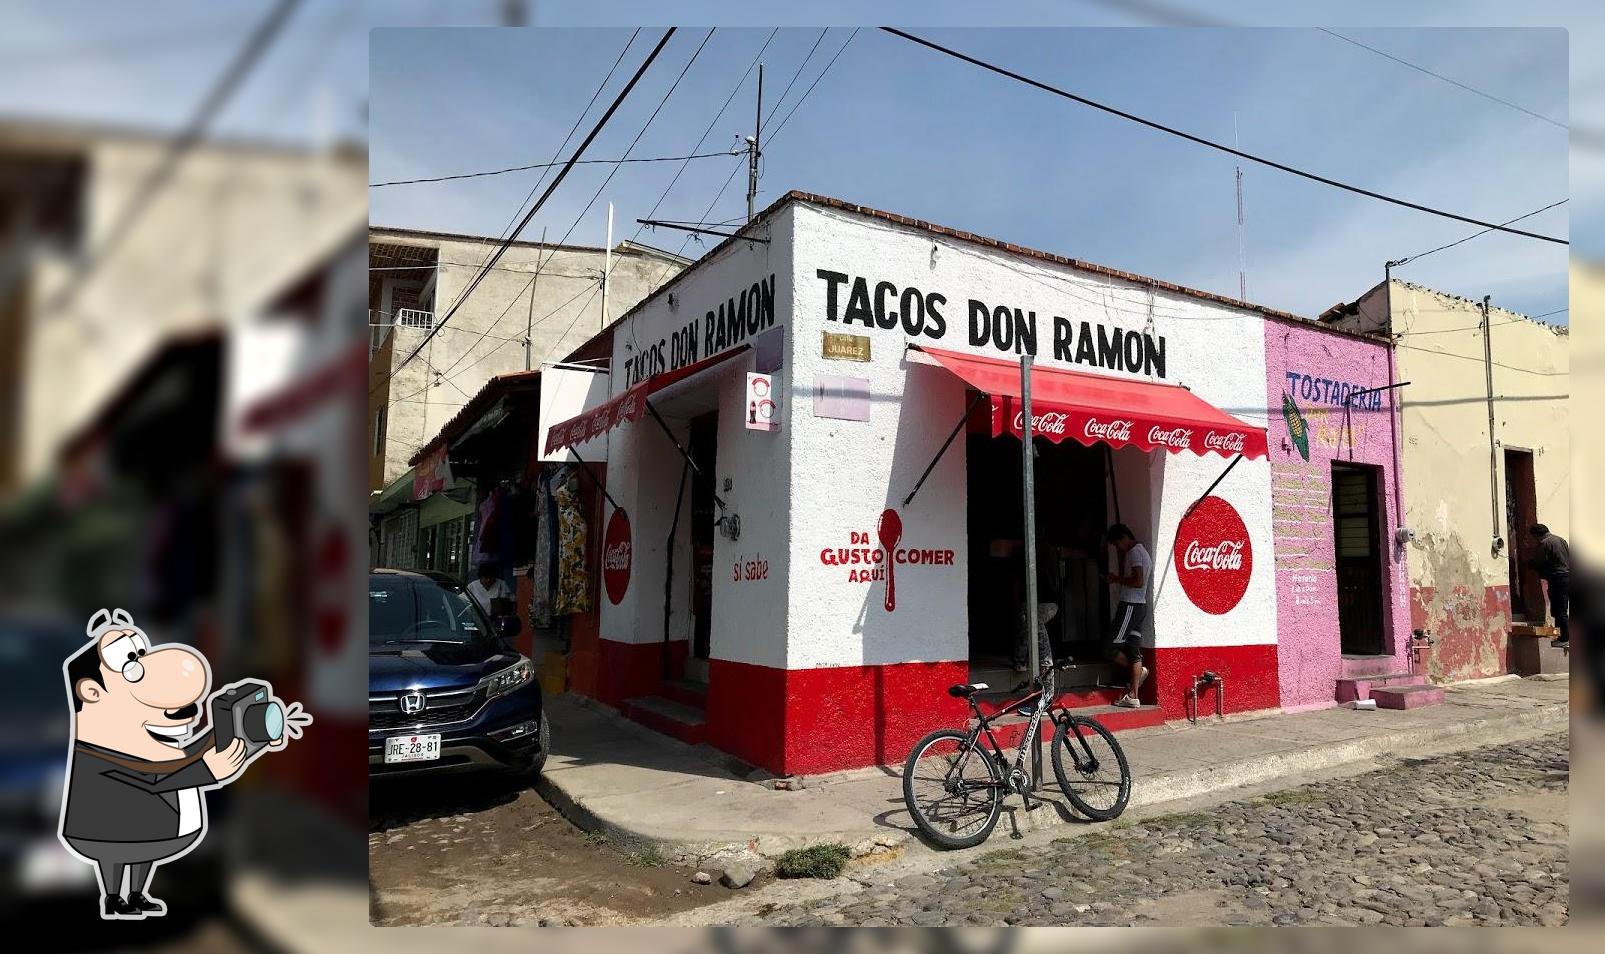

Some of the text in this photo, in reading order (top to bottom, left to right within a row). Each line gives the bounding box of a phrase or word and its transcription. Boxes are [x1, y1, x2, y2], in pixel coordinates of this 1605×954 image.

[625, 273, 776, 391] TACOS DON RAMON
[815, 268, 1167, 379] TACOS DON RAMON
[828, 344, 864, 356] JUAREZ
[1285, 371, 1382, 412] TOSTADERIA
[1013, 410, 1070, 434] Ca-Cola
[1084, 417, 1135, 442] Coca-Cola
[1147, 425, 1194, 449] Coca-Cola
[1204, 430, 1247, 452] Coca-Cola
[850, 531, 870, 545] DA
[745, 551, 769, 581] sabe
[820, 547, 955, 566] GUSTO COMER
[1183, 539, 1245, 571] Coca-Cola
[848, 565, 885, 583] AQUÍ
[387, 741, 438, 756] JRE-28-81
